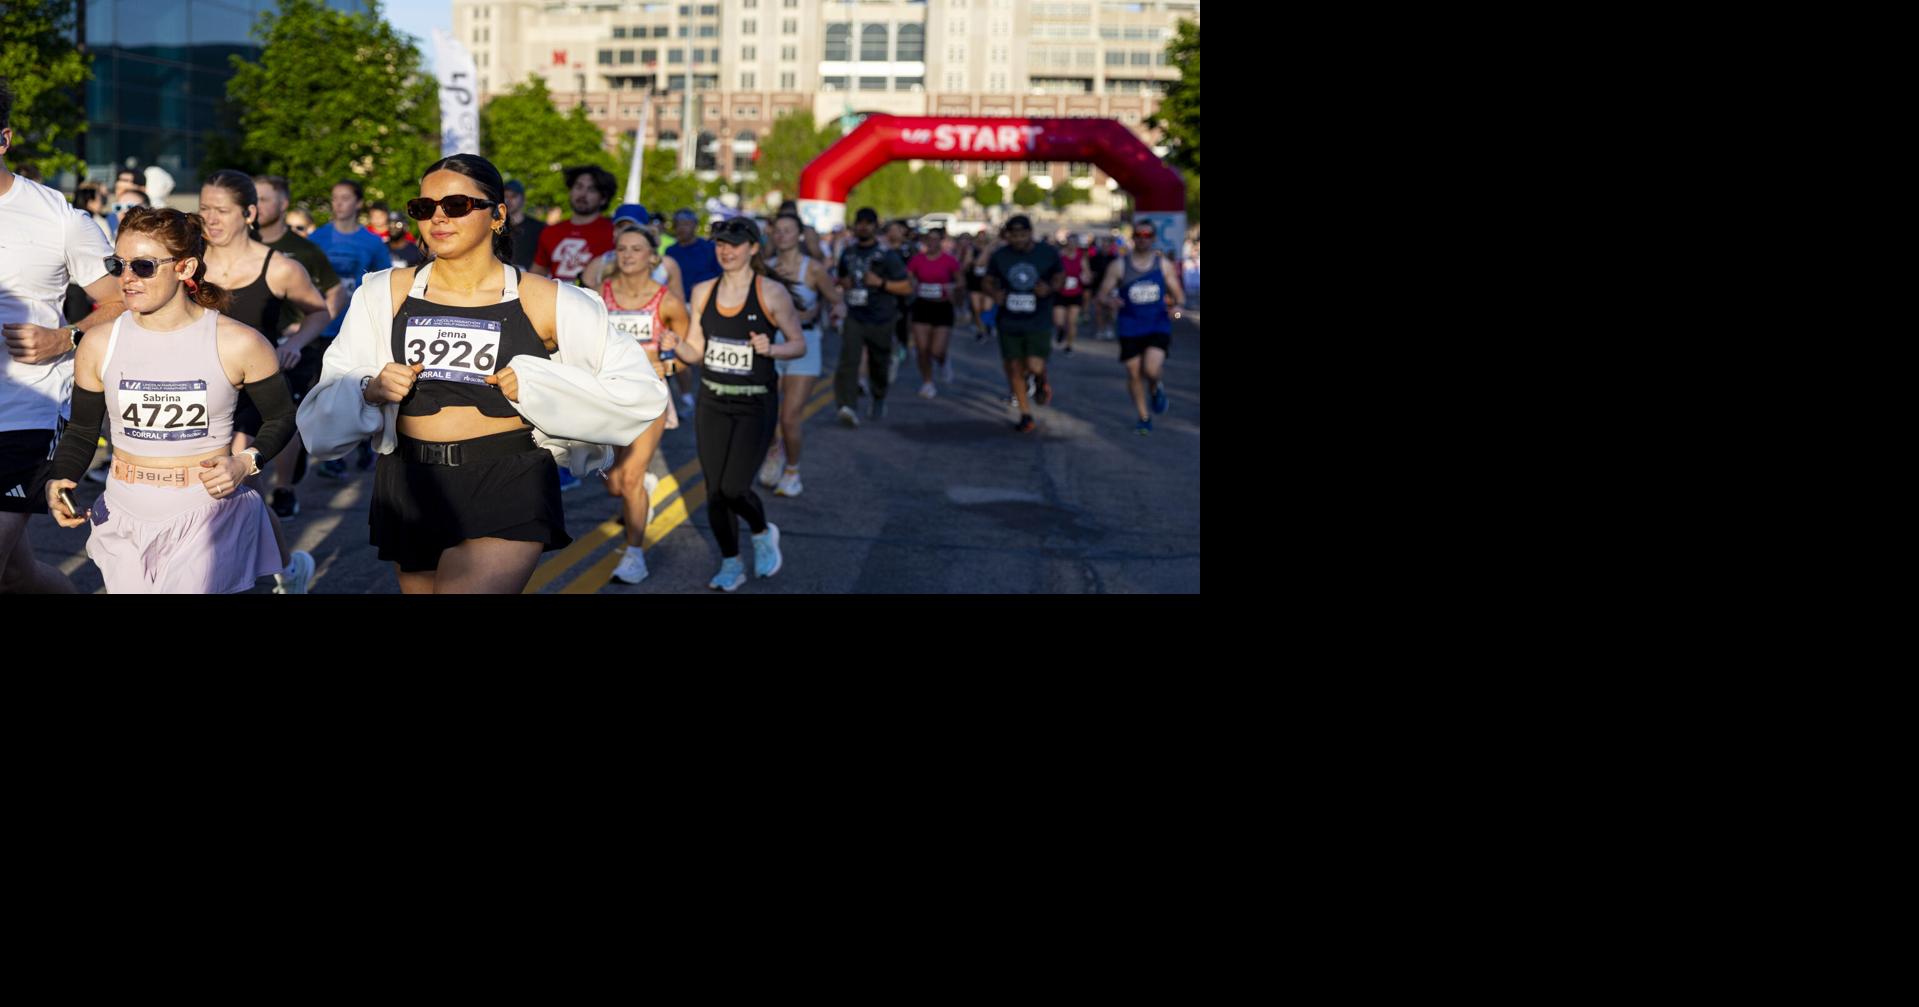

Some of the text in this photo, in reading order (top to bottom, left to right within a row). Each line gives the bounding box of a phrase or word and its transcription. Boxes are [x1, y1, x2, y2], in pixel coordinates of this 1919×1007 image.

[935, 124, 1043, 152] START
[437, 329, 467, 339] jenna
[611, 322, 651, 336] 844
[407, 338, 495, 371] 3926
[705, 349, 749, 368] 4401
[143, 393, 181, 402] Sabrina
[122, 403, 206, 429] 4722
[132, 430, 168, 440] CORRAL F
